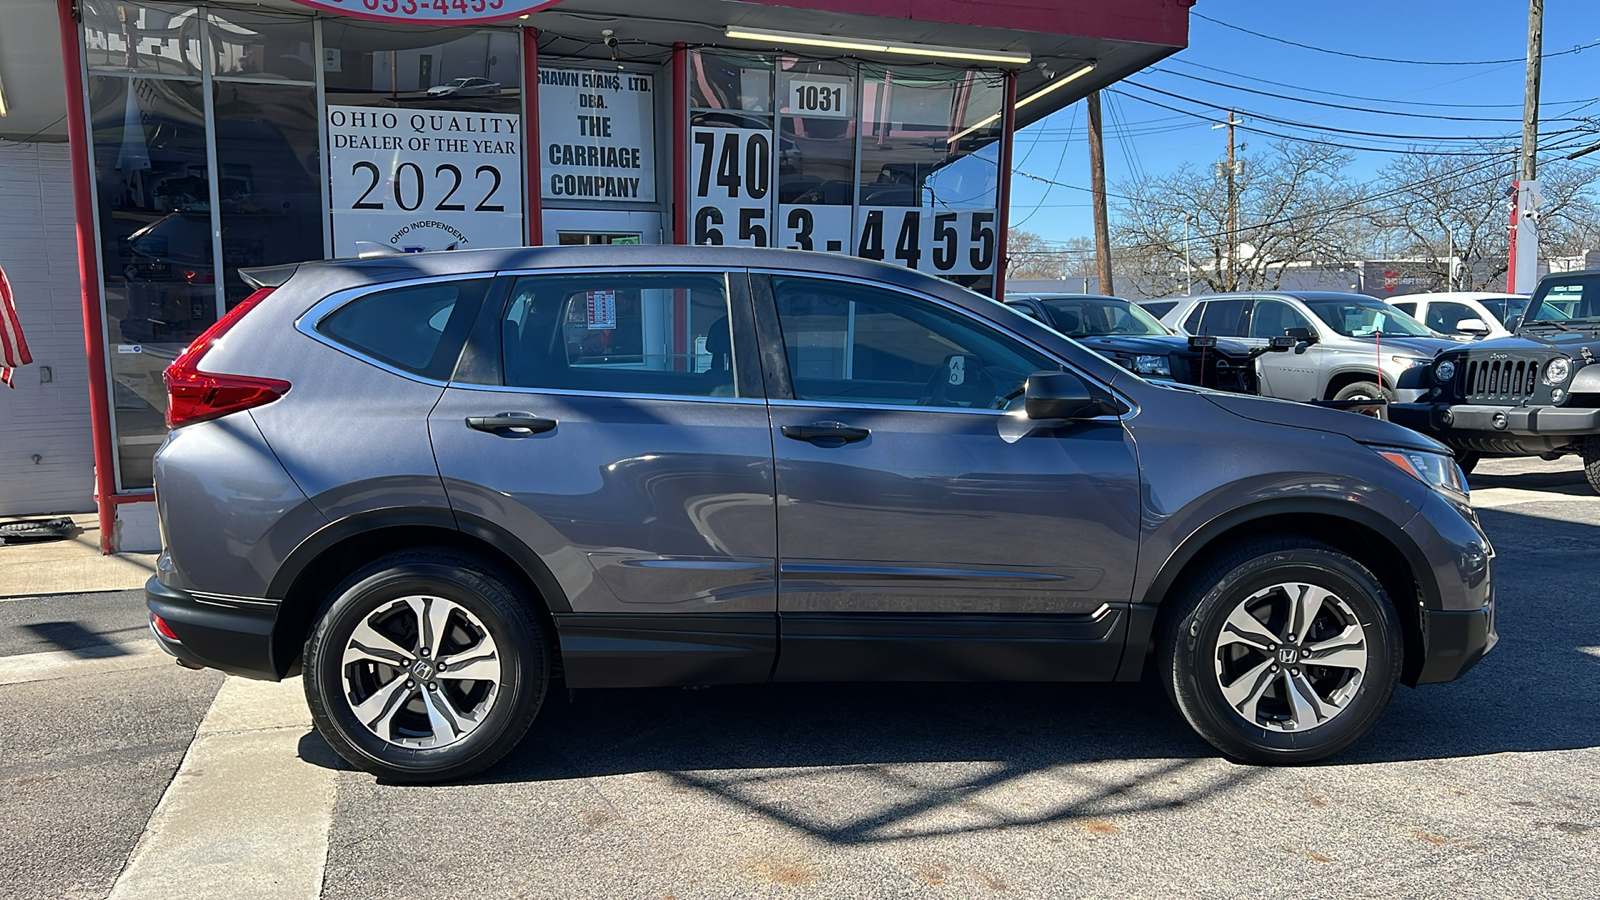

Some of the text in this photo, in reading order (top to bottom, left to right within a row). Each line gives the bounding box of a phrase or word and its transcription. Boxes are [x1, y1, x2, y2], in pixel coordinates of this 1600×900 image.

[628, 77, 651, 92] LTD.
[579, 93, 608, 109] DBA.
[795, 85, 842, 112] 1031
[330, 110, 518, 134] OHIO QUALITY
[577, 115, 612, 138] THE
[334, 134, 516, 155] DEALER OF THE YEAR
[548, 143, 641, 169] CARRIAGE
[694, 131, 769, 200] 740
[351, 160, 505, 212] 2022
[550, 174, 640, 198] COMPANY
[390, 220, 469, 245] OHIO INDEPENDENT
